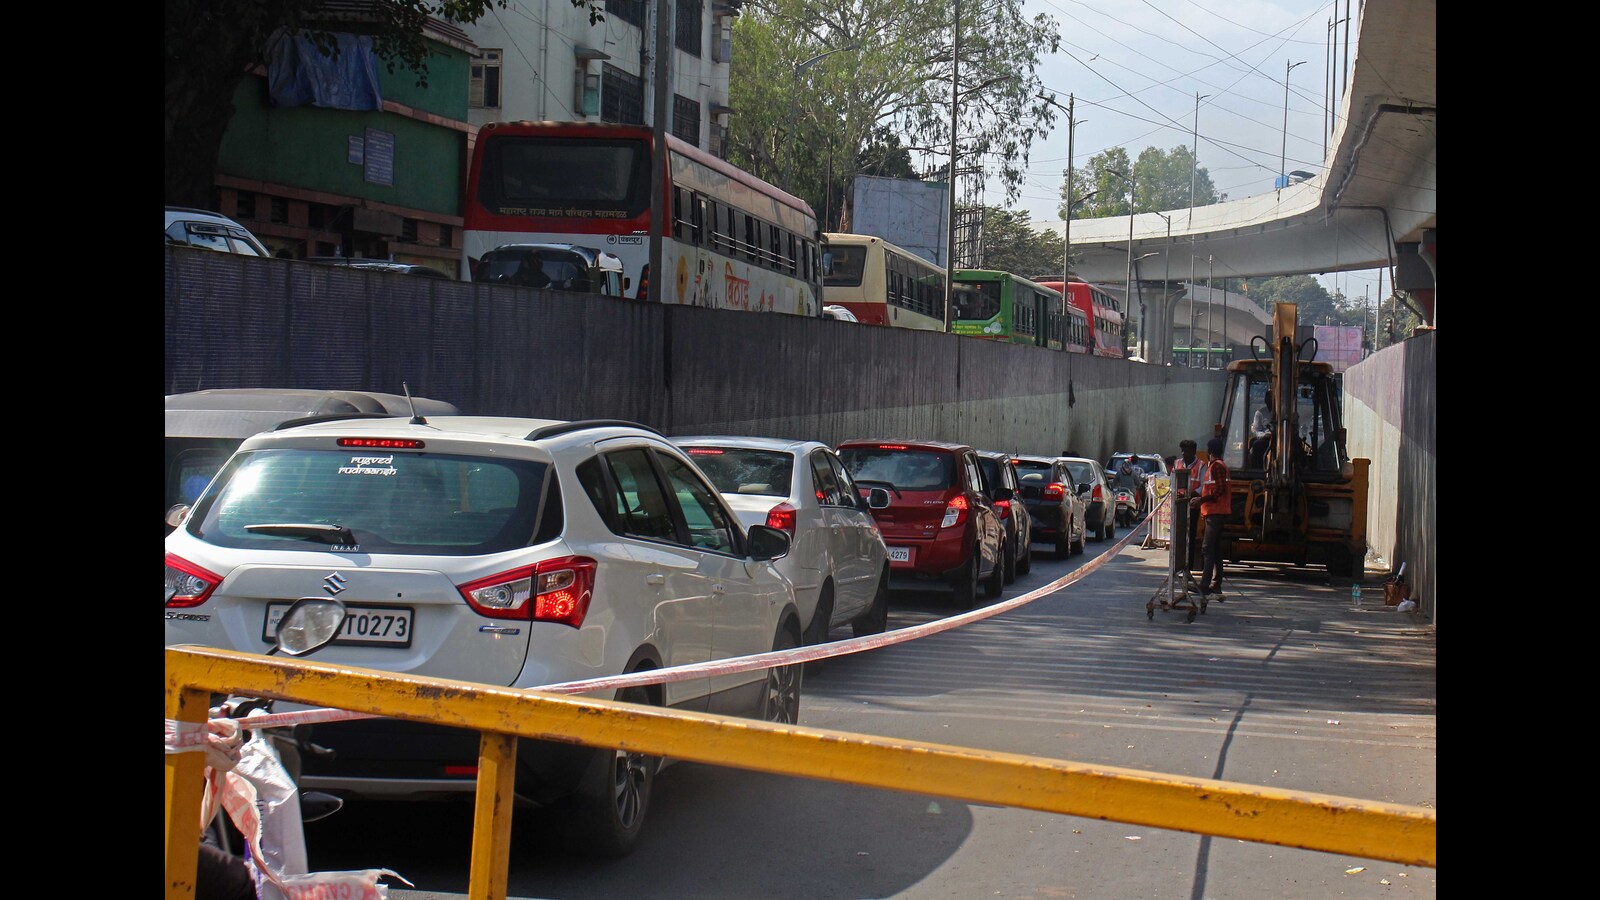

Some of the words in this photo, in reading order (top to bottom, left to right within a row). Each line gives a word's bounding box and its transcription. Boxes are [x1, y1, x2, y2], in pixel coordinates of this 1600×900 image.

[529, 208, 546, 216] राज्य
[548, 207, 563, 217] मार्ग
[565, 207, 592, 217] परिवहन
[595, 209, 628, 218] महामंडळ
[725, 261, 750, 311] विठाई
[350, 455, 394, 465] rugved
[338, 464, 398, 476] rudraansh
[890, 551, 908, 560] 4279
[341, 614, 407, 637] T0273
